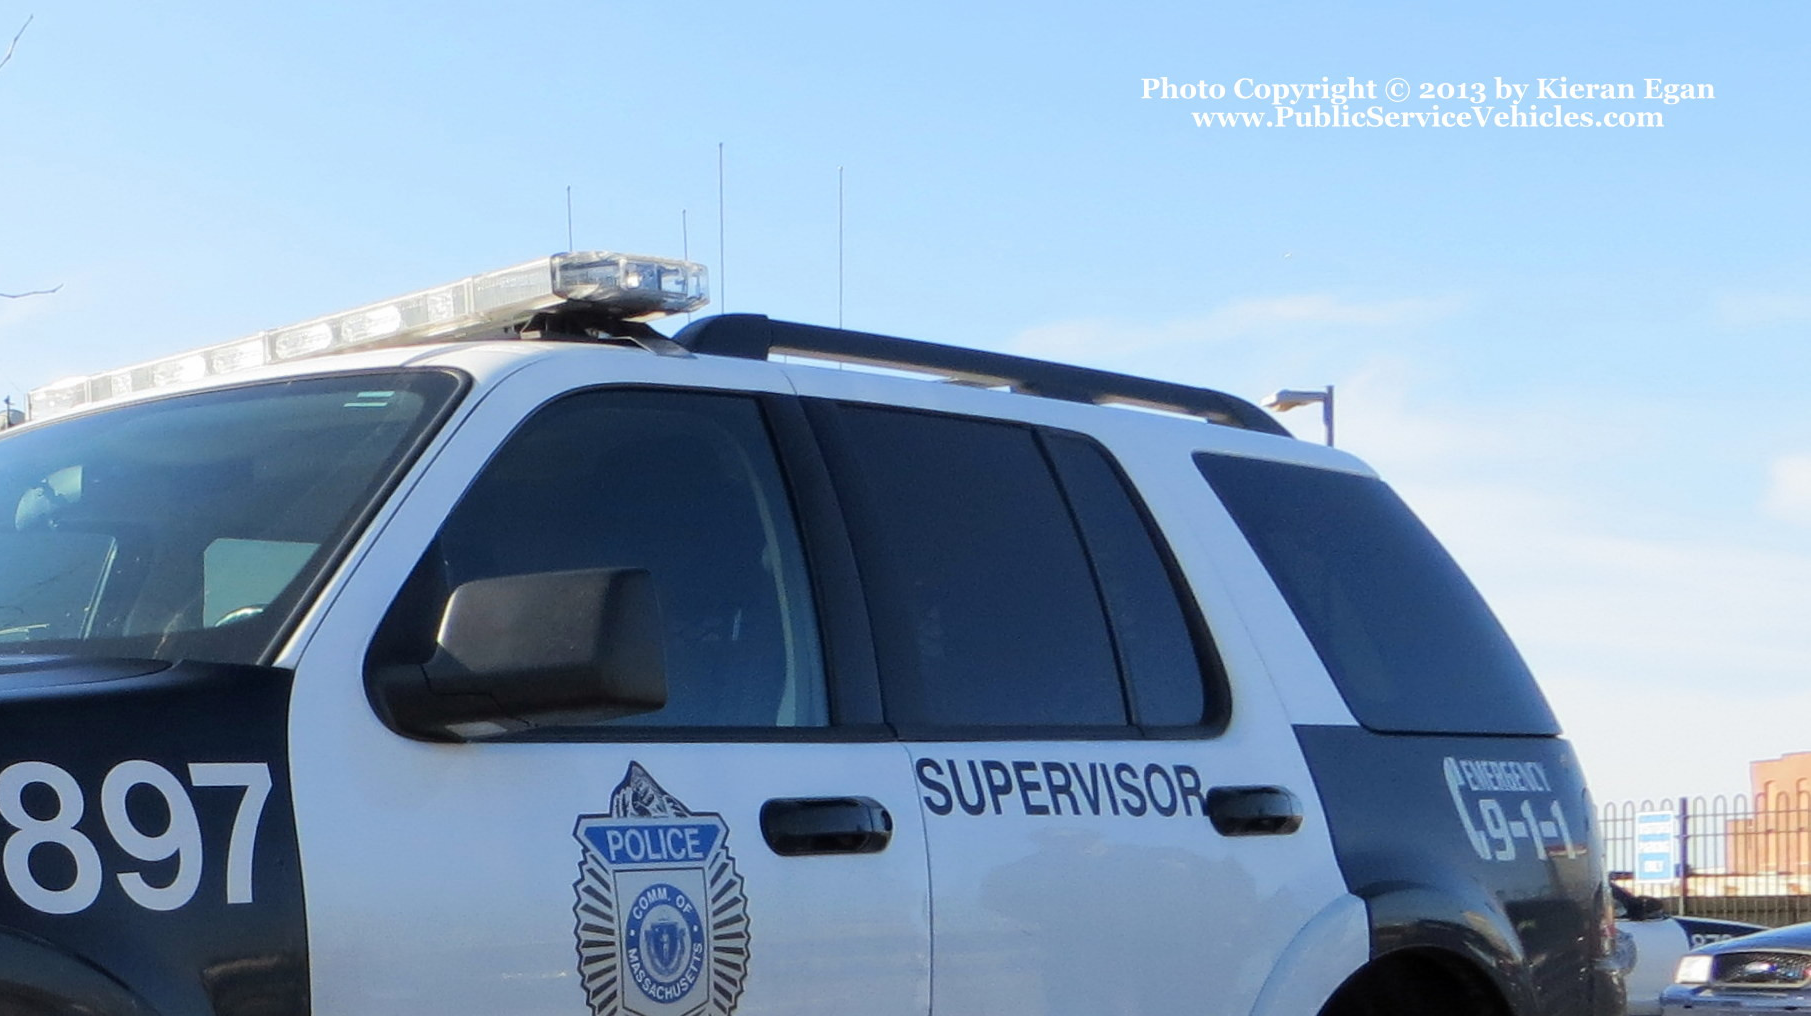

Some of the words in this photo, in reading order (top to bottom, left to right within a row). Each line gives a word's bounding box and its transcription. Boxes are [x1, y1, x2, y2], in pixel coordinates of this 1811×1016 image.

[915, 757, 1210, 818] SUPERVISOR
[606, 827, 705, 862] POLICE
[1479, 799, 1577, 861] 9-1-1
[632, 887, 671, 920] COMM.
[675, 895, 694, 916] OF
[627, 943, 703, 1000] MASSACHUSETTS
